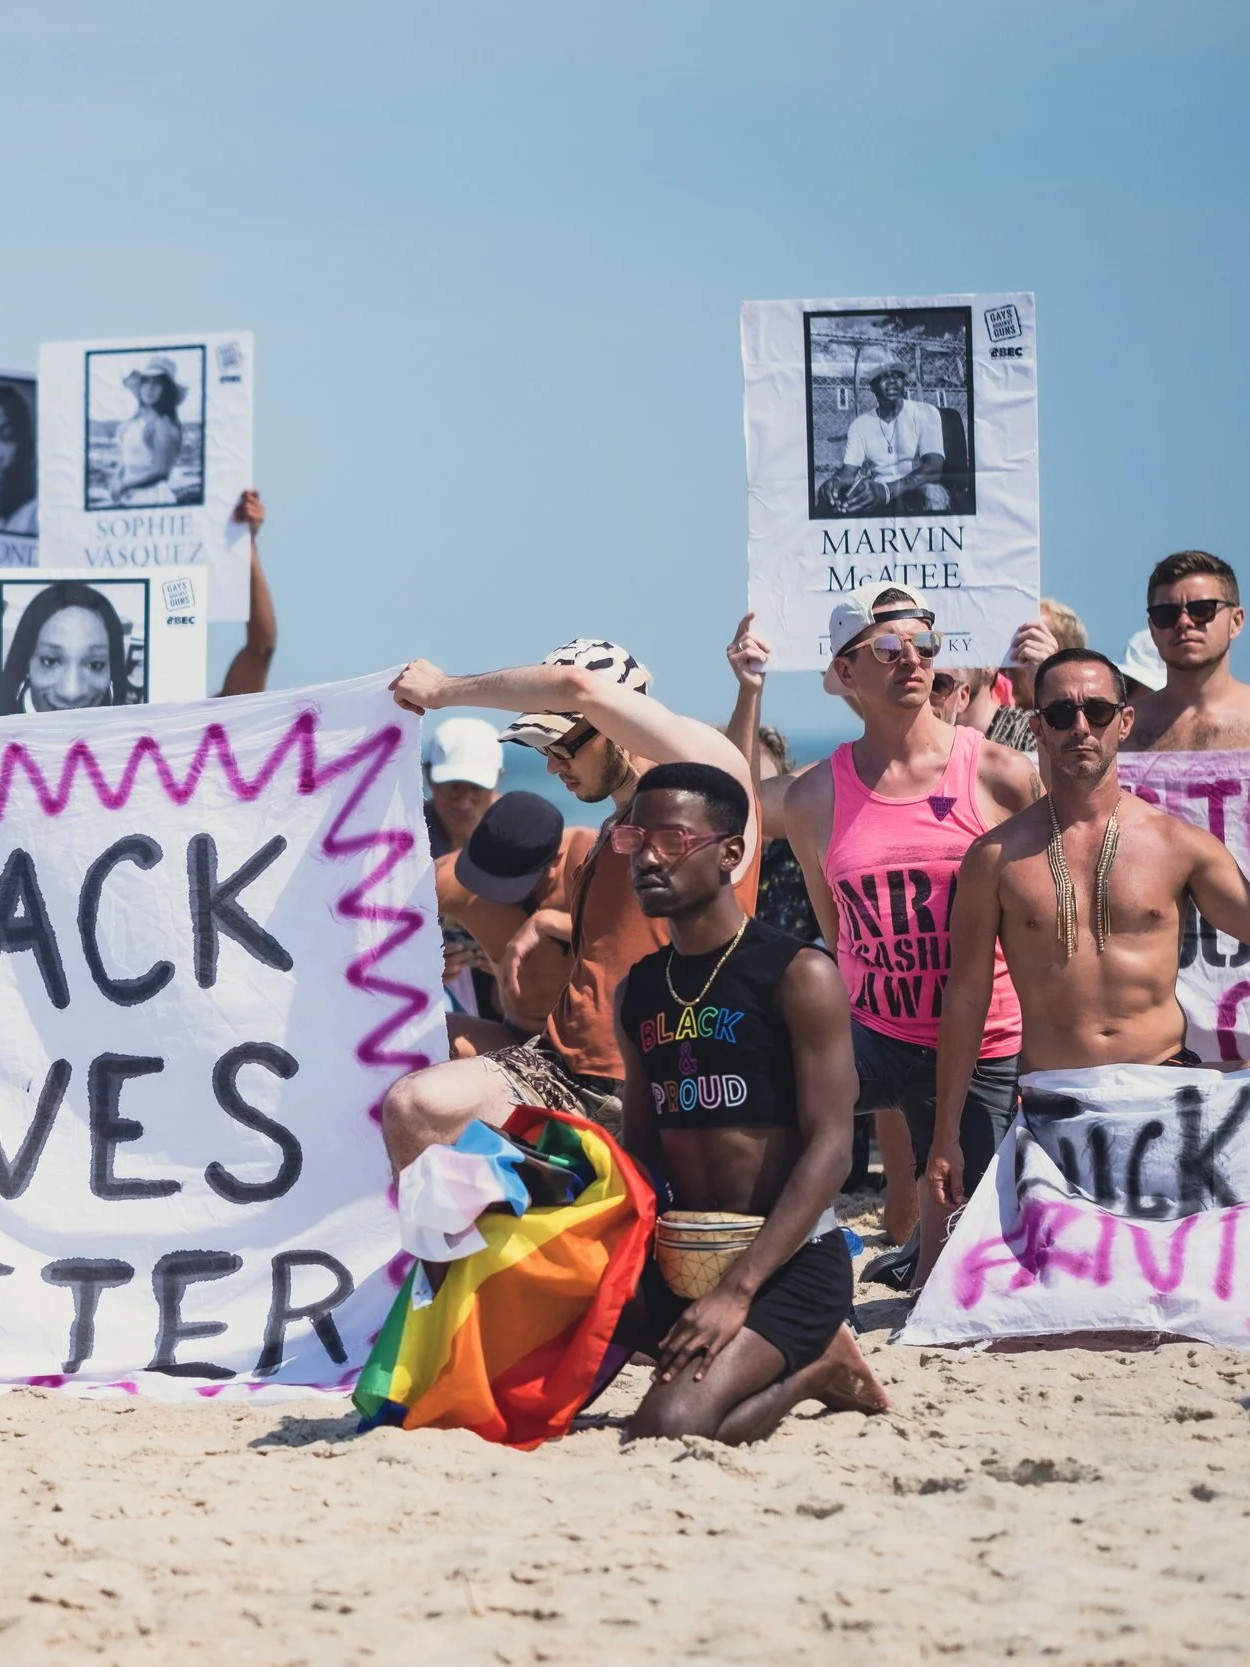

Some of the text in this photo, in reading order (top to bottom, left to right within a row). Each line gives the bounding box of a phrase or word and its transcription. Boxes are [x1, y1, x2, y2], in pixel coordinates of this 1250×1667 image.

[990, 309, 1012, 321] GAYS
[994, 325, 1016, 338] GUNS
[96, 513, 194, 540] SOPHIE
[821, 525, 966, 555] MARVIN
[640, 1006, 745, 1053] BLACK
[678, 1041, 698, 1075] &
[651, 1074, 747, 1115] PROUD
